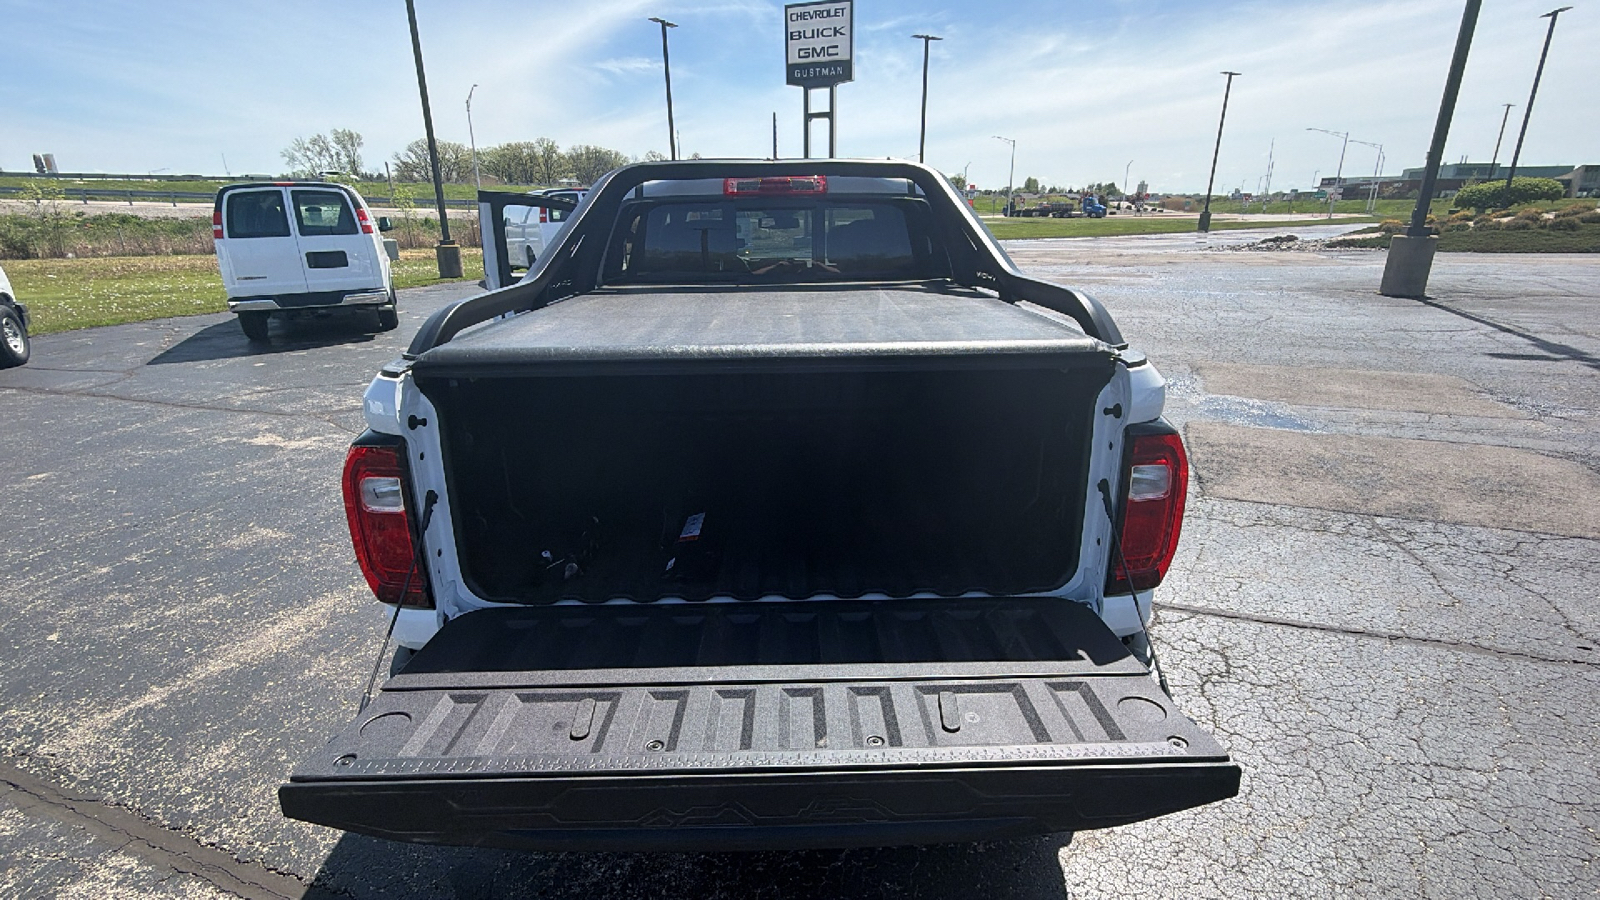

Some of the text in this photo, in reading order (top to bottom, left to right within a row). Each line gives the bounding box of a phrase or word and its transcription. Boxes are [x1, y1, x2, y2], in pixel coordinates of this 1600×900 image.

[790, 7, 846, 22] CHEVROLET
[790, 26, 846, 41] BUICK
[798, 45, 839, 59] GMC
[794, 66, 843, 78] GUSTMAN
